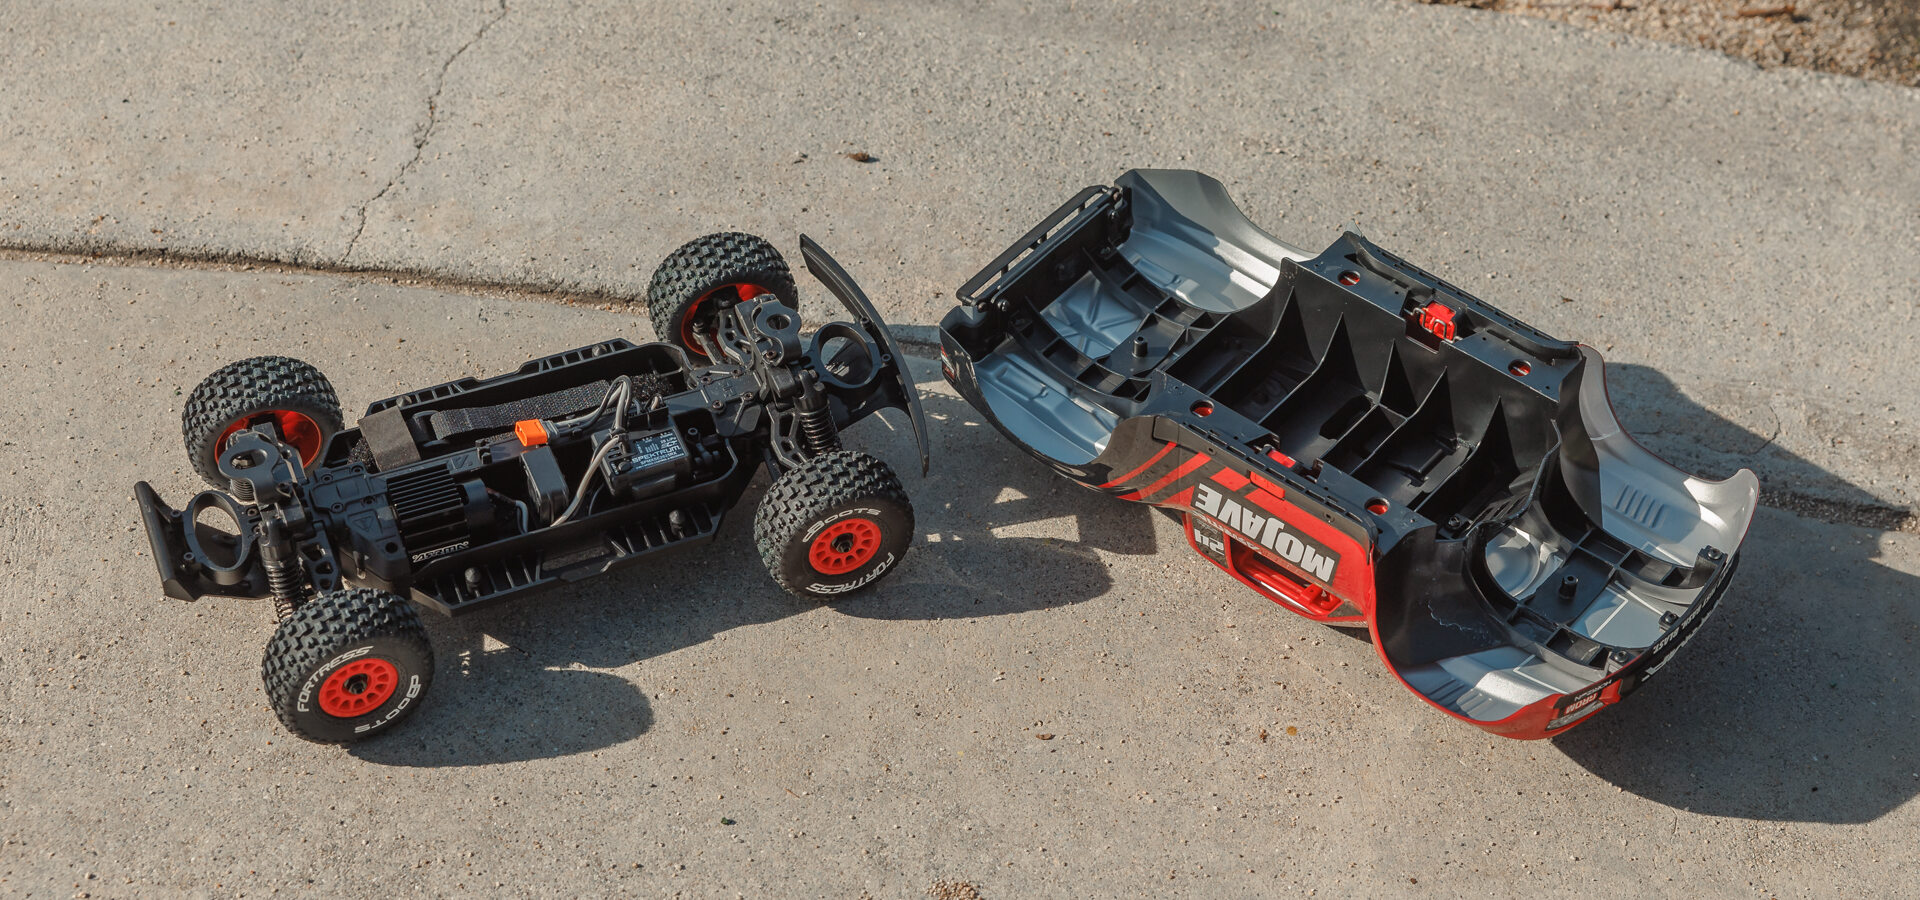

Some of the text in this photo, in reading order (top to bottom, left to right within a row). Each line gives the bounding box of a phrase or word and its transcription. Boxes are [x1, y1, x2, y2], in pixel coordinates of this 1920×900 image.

[632, 445, 681, 464] SPEKTRUM
[1195, 483, 1335, 583] MOJAVE
[805, 551, 895, 594] FORTRESS
[297, 645, 374, 713] FORTRESS
